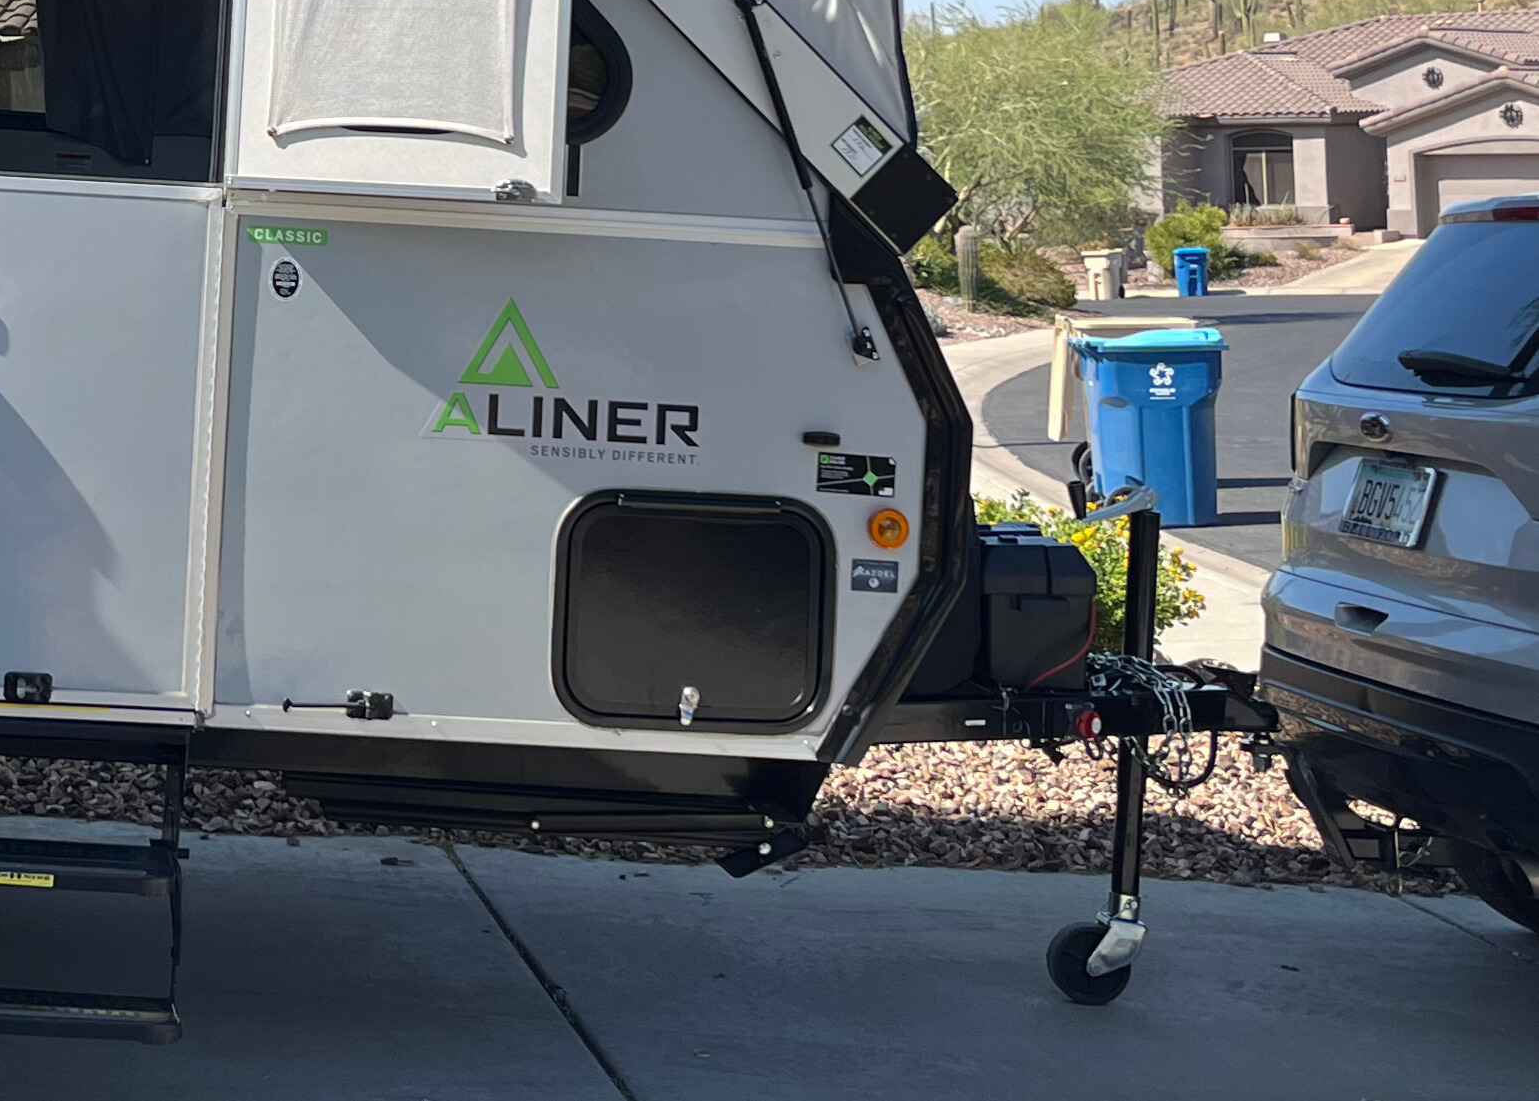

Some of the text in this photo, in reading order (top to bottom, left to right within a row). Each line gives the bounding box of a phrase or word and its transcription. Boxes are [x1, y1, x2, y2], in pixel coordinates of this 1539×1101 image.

[254, 228, 322, 243] CLASSIC
[432, 392, 700, 447] ALINER
[530, 445, 606, 460] SENSIBLY
